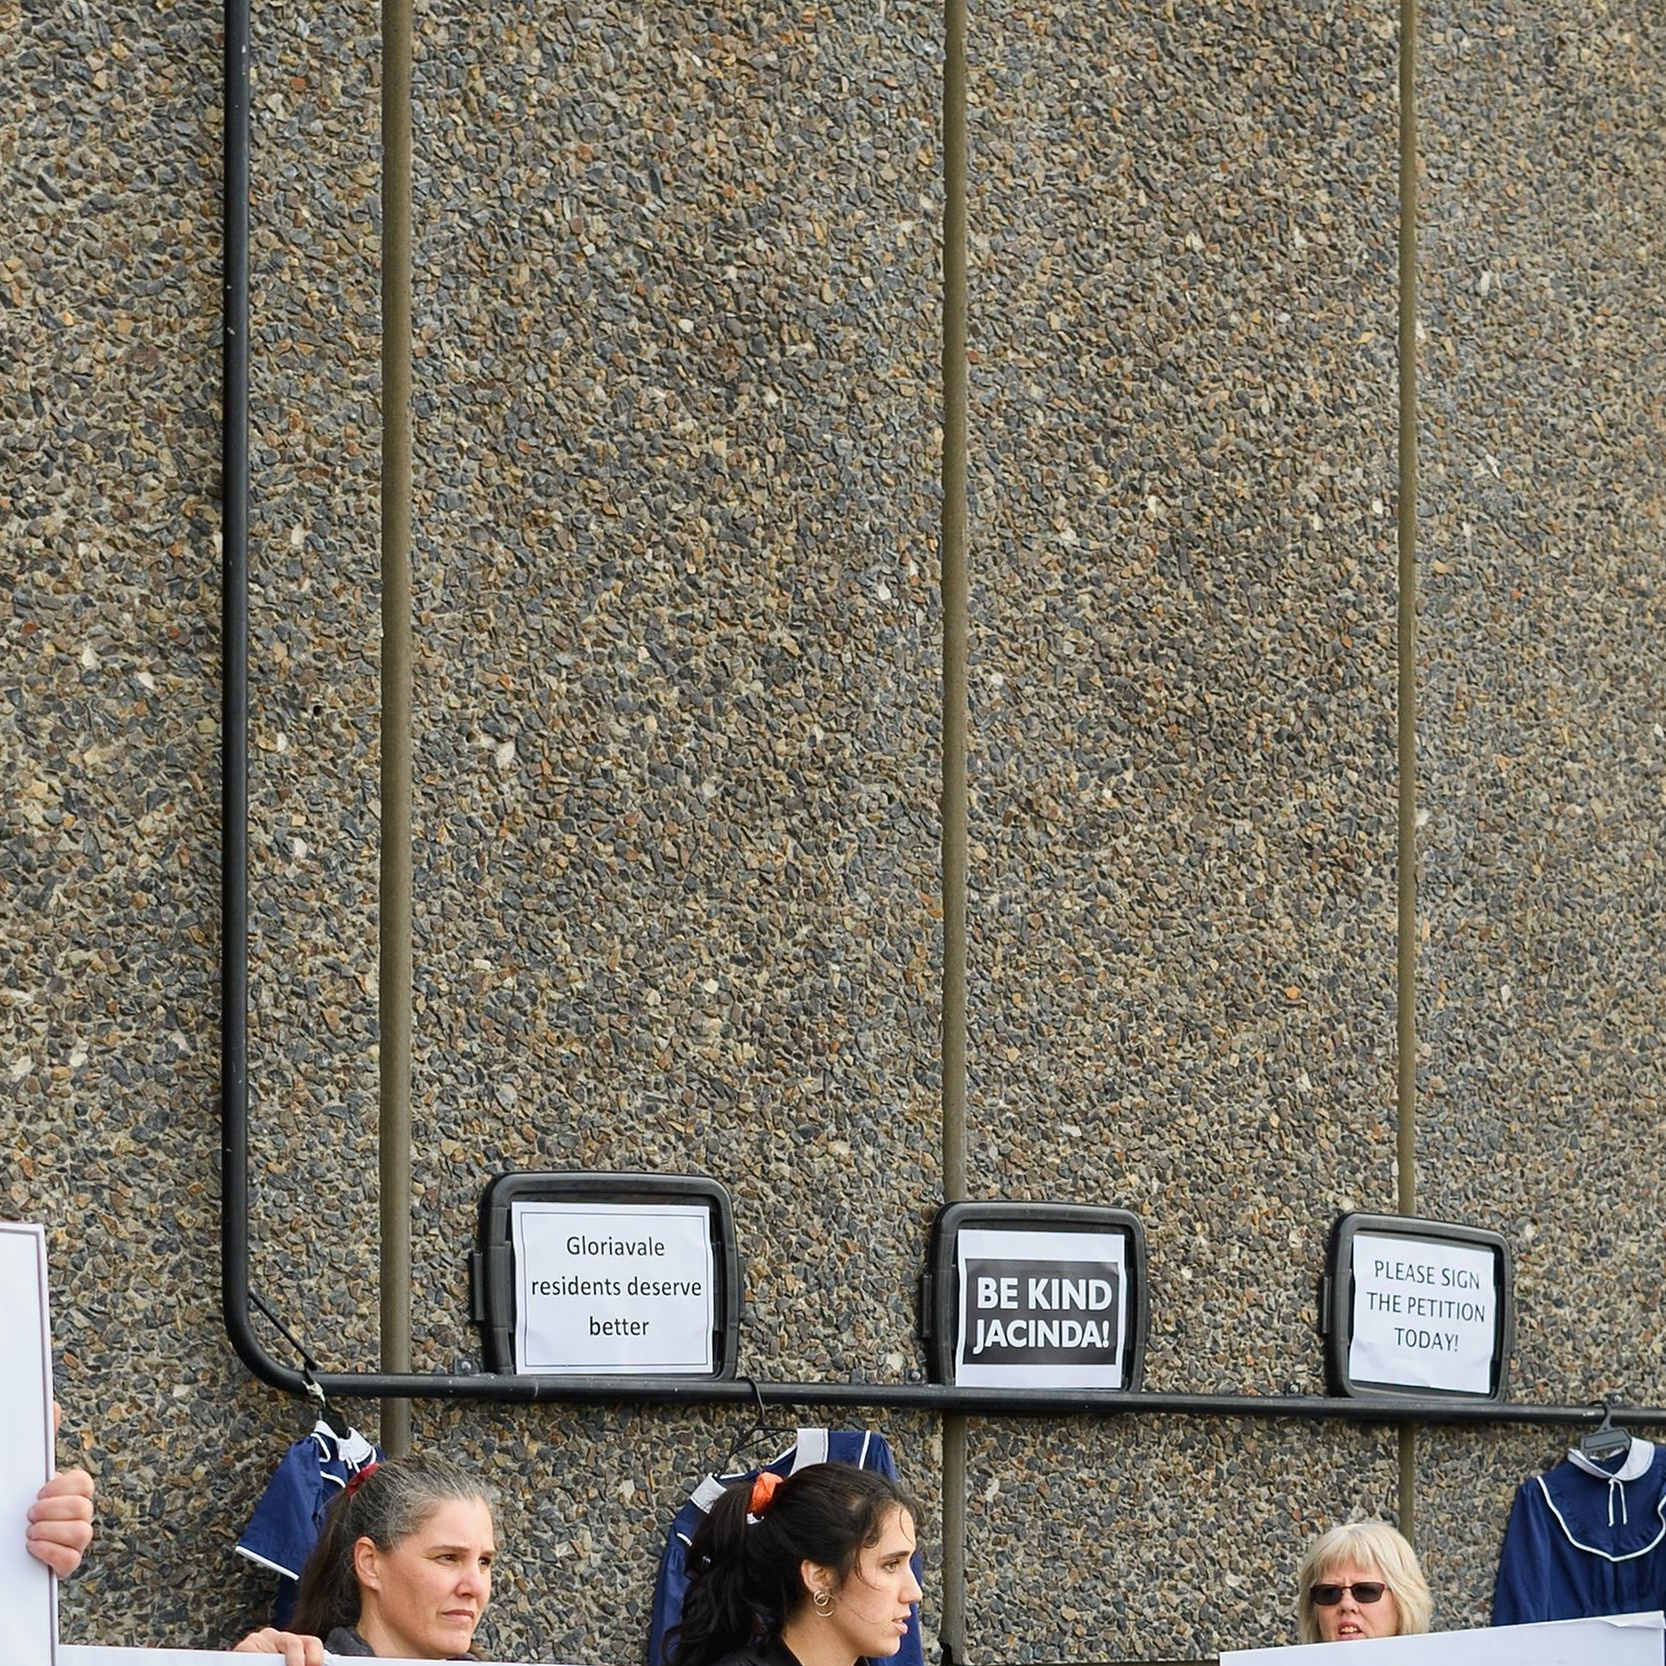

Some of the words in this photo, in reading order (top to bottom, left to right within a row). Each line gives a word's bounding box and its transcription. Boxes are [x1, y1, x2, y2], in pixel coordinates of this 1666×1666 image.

[566, 1236, 665, 1256] Gloriavale
[532, 1276, 621, 1296] residents
[627, 1276, 702, 1296] deserve
[1375, 1260, 1435, 1285] PLEASE
[1441, 1268, 1480, 1290] SIGN
[977, 1277, 1018, 1309] BE
[1028, 1278, 1112, 1310] KIND
[1367, 1292, 1402, 1313] THE
[1408, 1297, 1485, 1322] PETITION
[589, 1316, 649, 1336] better
[973, 1319, 1109, 1354] JACINDA!
[1394, 1328, 1459, 1352] TODAY!
